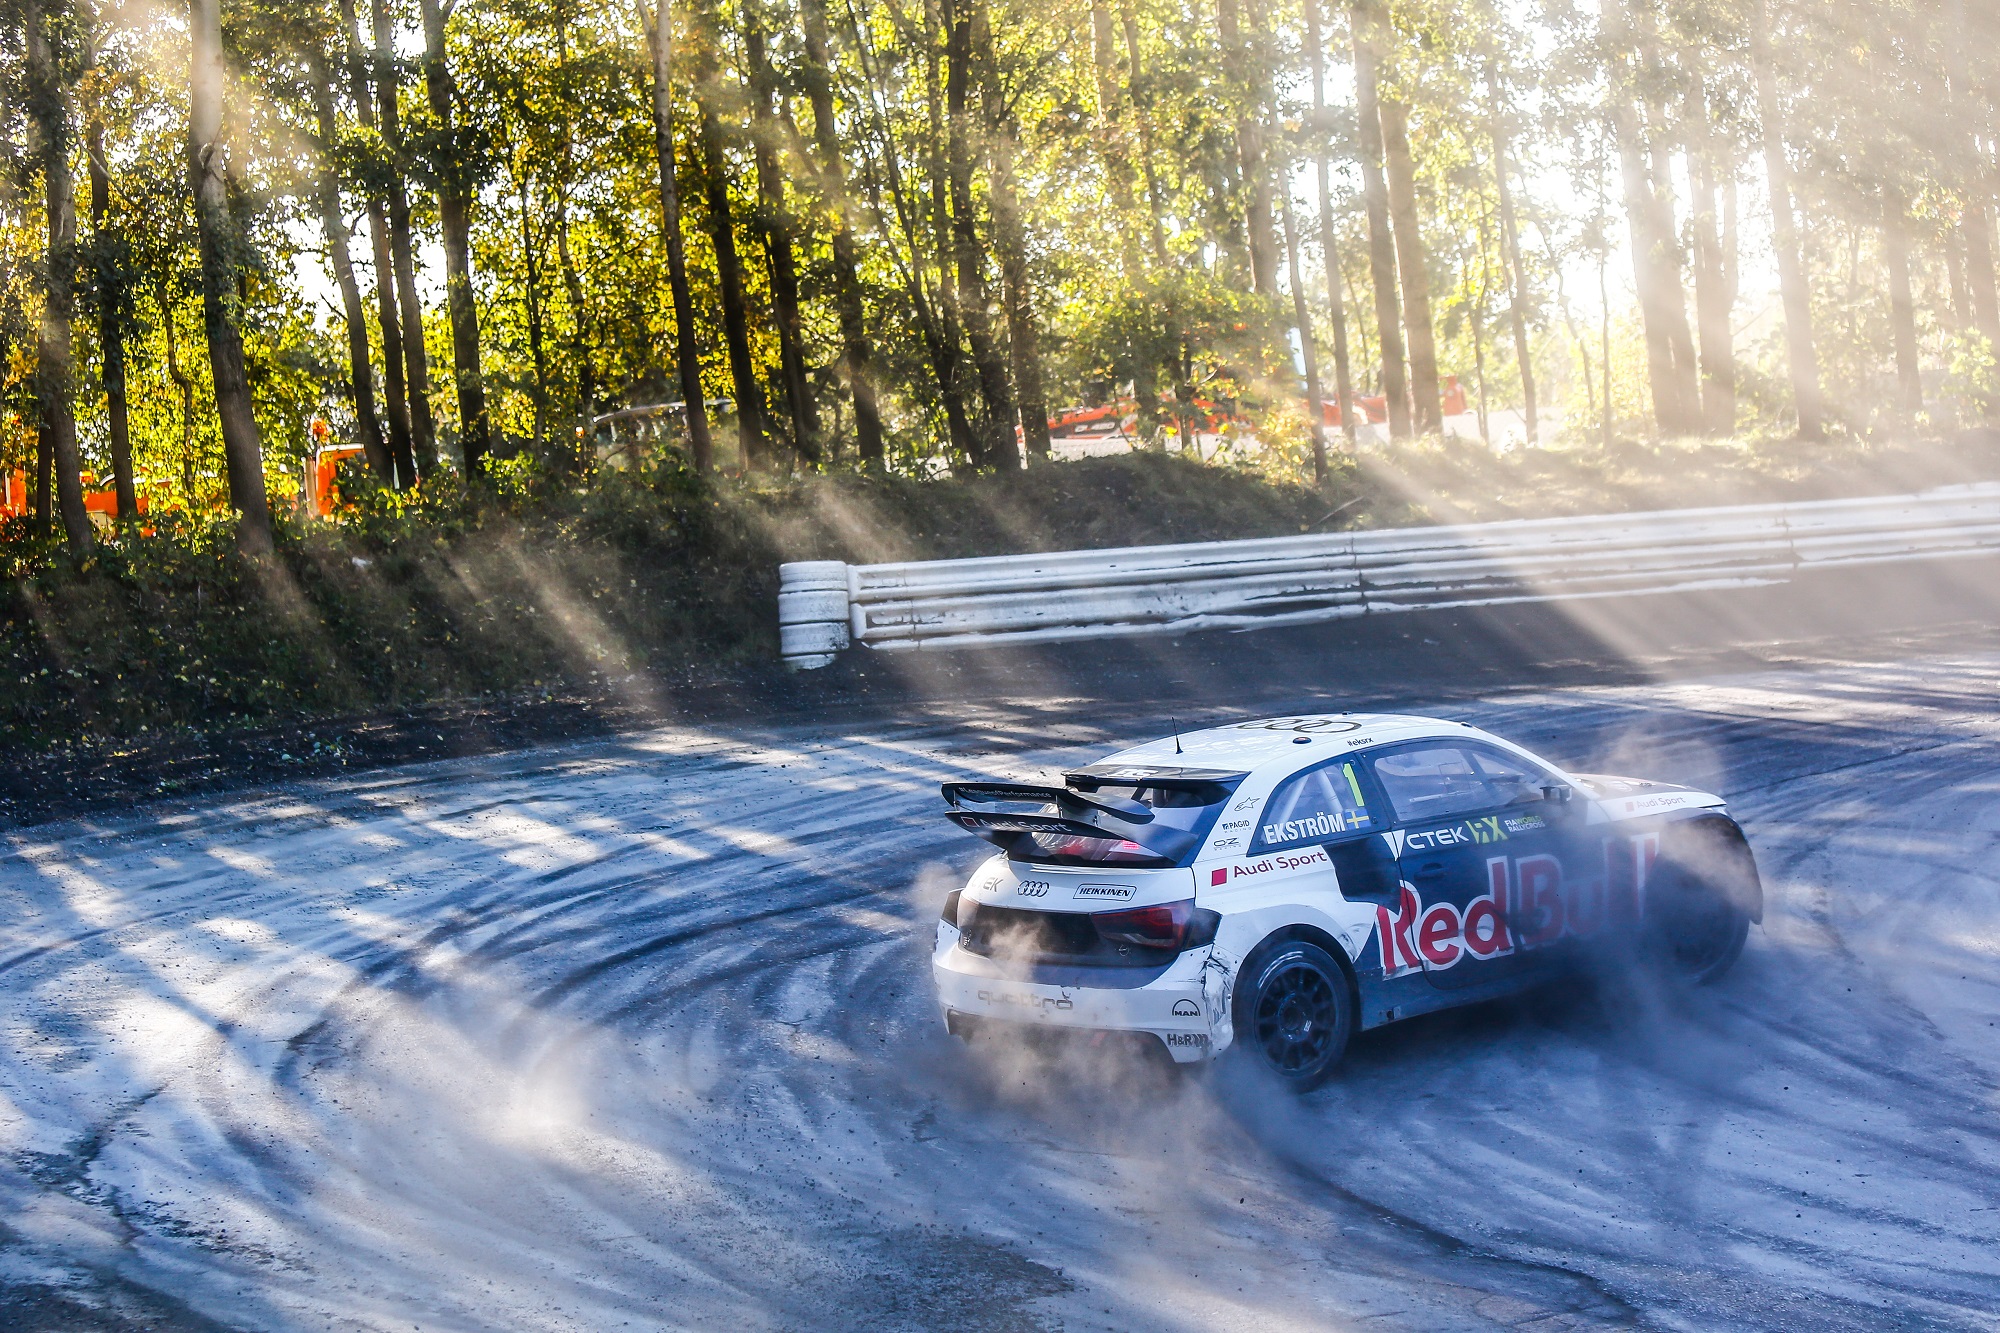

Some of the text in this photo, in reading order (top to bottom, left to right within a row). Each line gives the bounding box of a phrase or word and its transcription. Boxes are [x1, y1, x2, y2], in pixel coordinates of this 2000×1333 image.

[1342, 763, 1365, 807] 1
[1636, 796, 1686, 809] Audi Sport
[980, 818, 1072, 833] Audi Sport
[1229, 820, 1250, 829] PAGID
[1263, 812, 1346, 844] EKSTRÖM
[1508, 821, 1546, 833] RALLYCROSS
[1213, 837, 1240, 847] OZ
[1406, 826, 1470, 850] CTEK
[1234, 850, 1328, 879] Audi Sport
[1079, 887, 1131, 897] HEIKKINEN
[1376, 855, 1516, 981] Red
[1166, 1033, 1193, 1046] H&R
